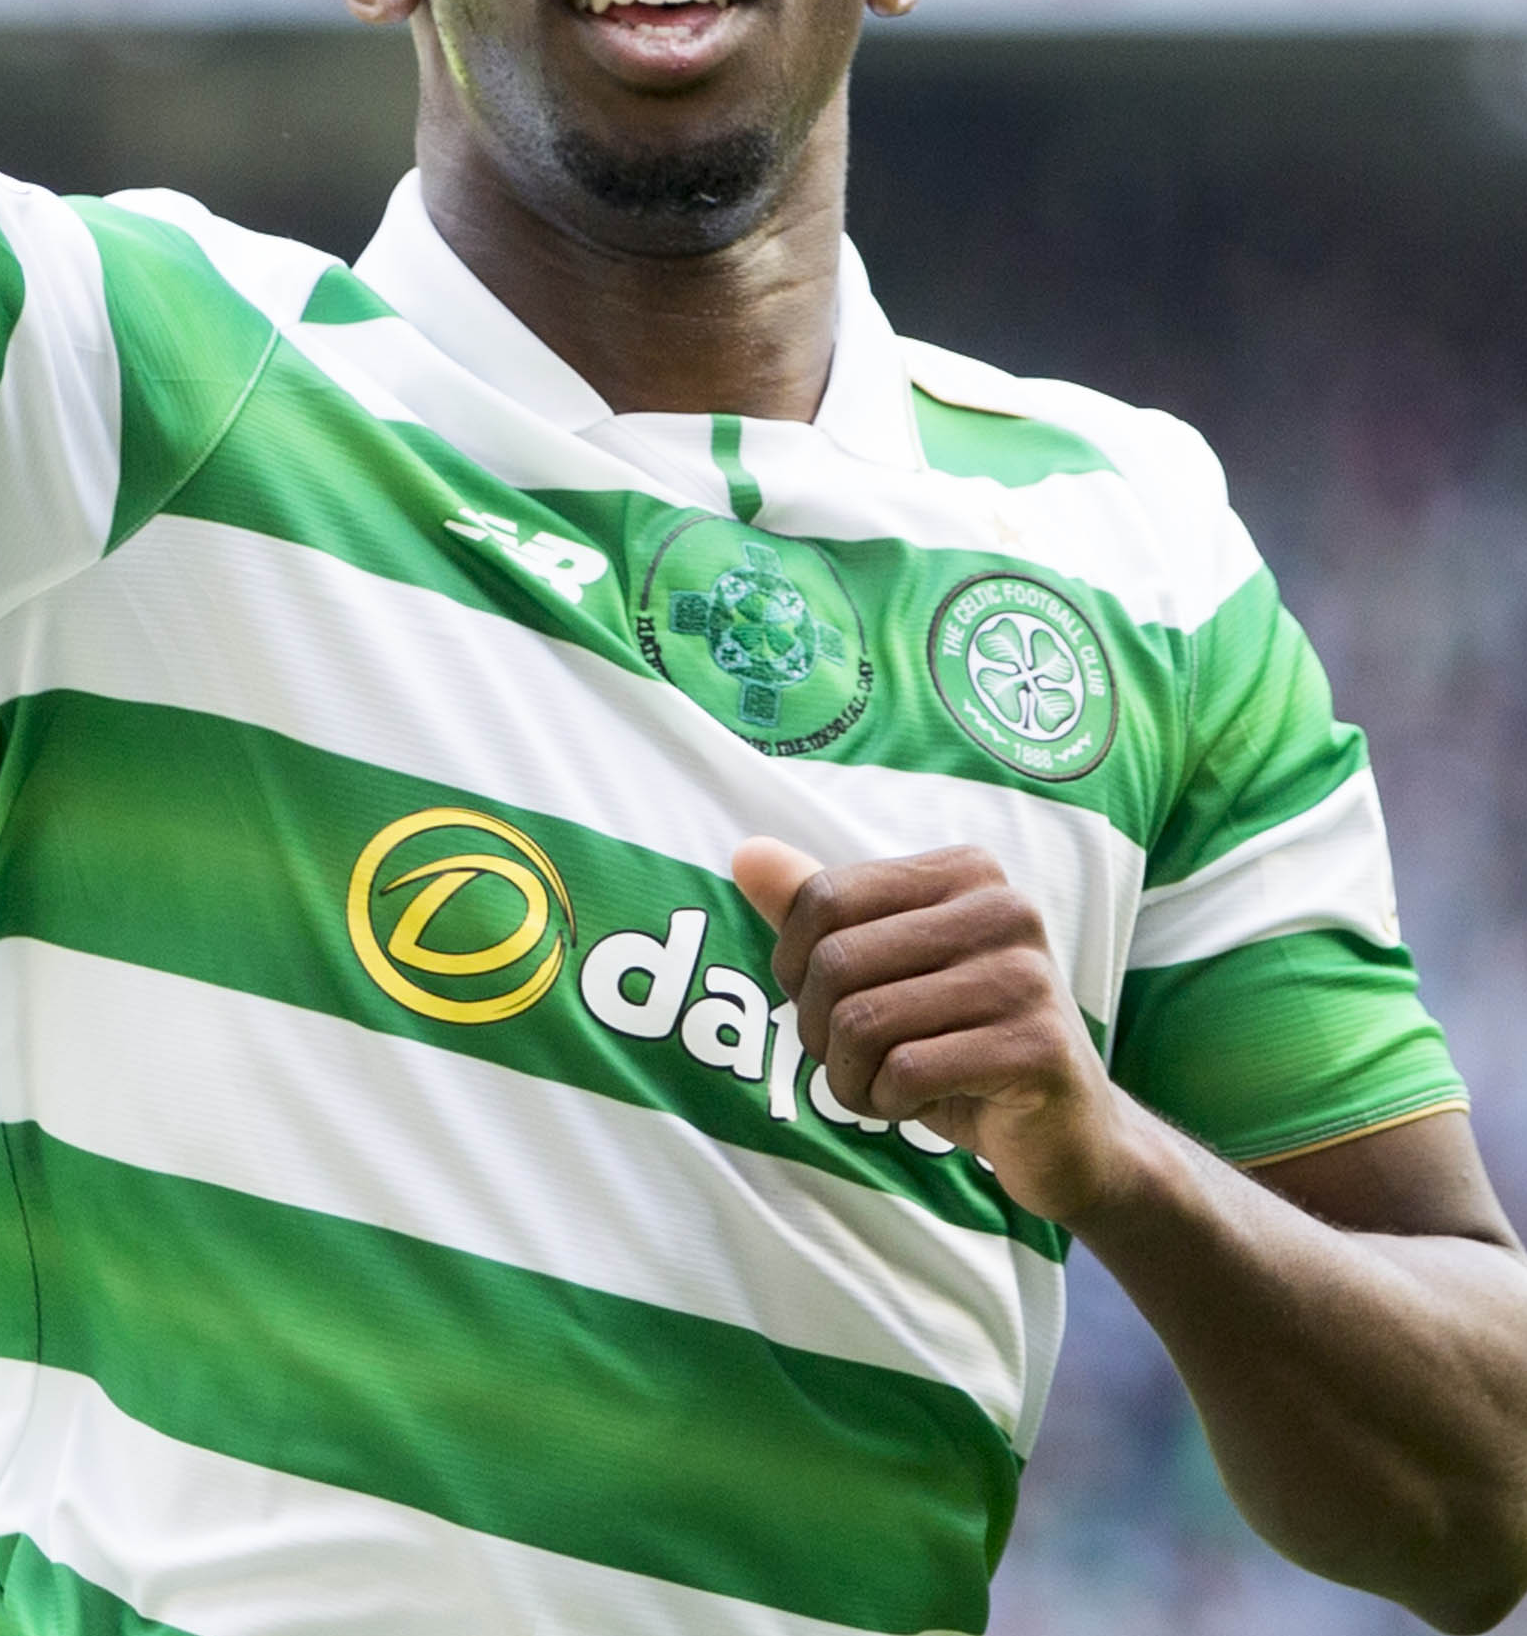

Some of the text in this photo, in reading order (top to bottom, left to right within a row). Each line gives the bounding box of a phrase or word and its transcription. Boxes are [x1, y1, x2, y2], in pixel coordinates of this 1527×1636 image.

[943, 583, 1106, 697] THE CELTIC FOOTBALL CLUB
[1013, 742, 1054, 768] 1888
